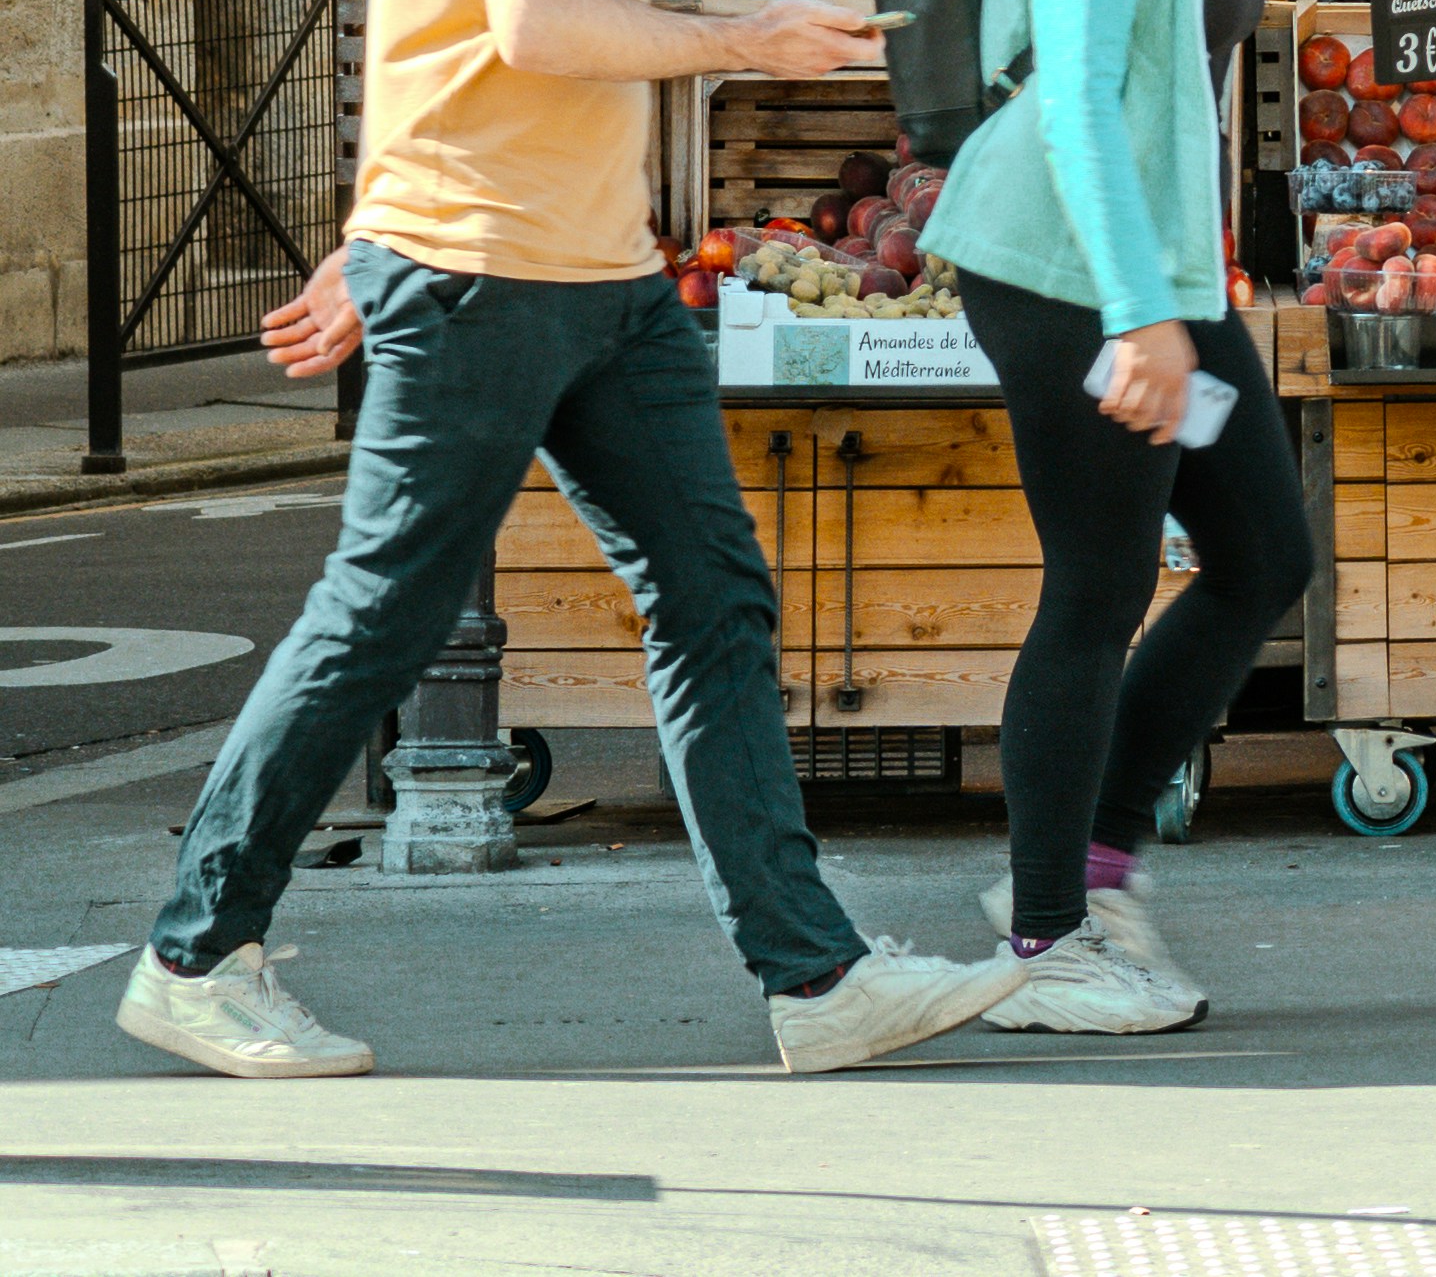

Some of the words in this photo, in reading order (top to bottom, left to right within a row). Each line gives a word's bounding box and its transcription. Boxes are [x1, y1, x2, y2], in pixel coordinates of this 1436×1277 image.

[859, 331, 934, 351] Amandes
[940, 332, 958, 349] de
[965, 332, 977, 349] la
[865, 360, 971, 379] Méditerranée
